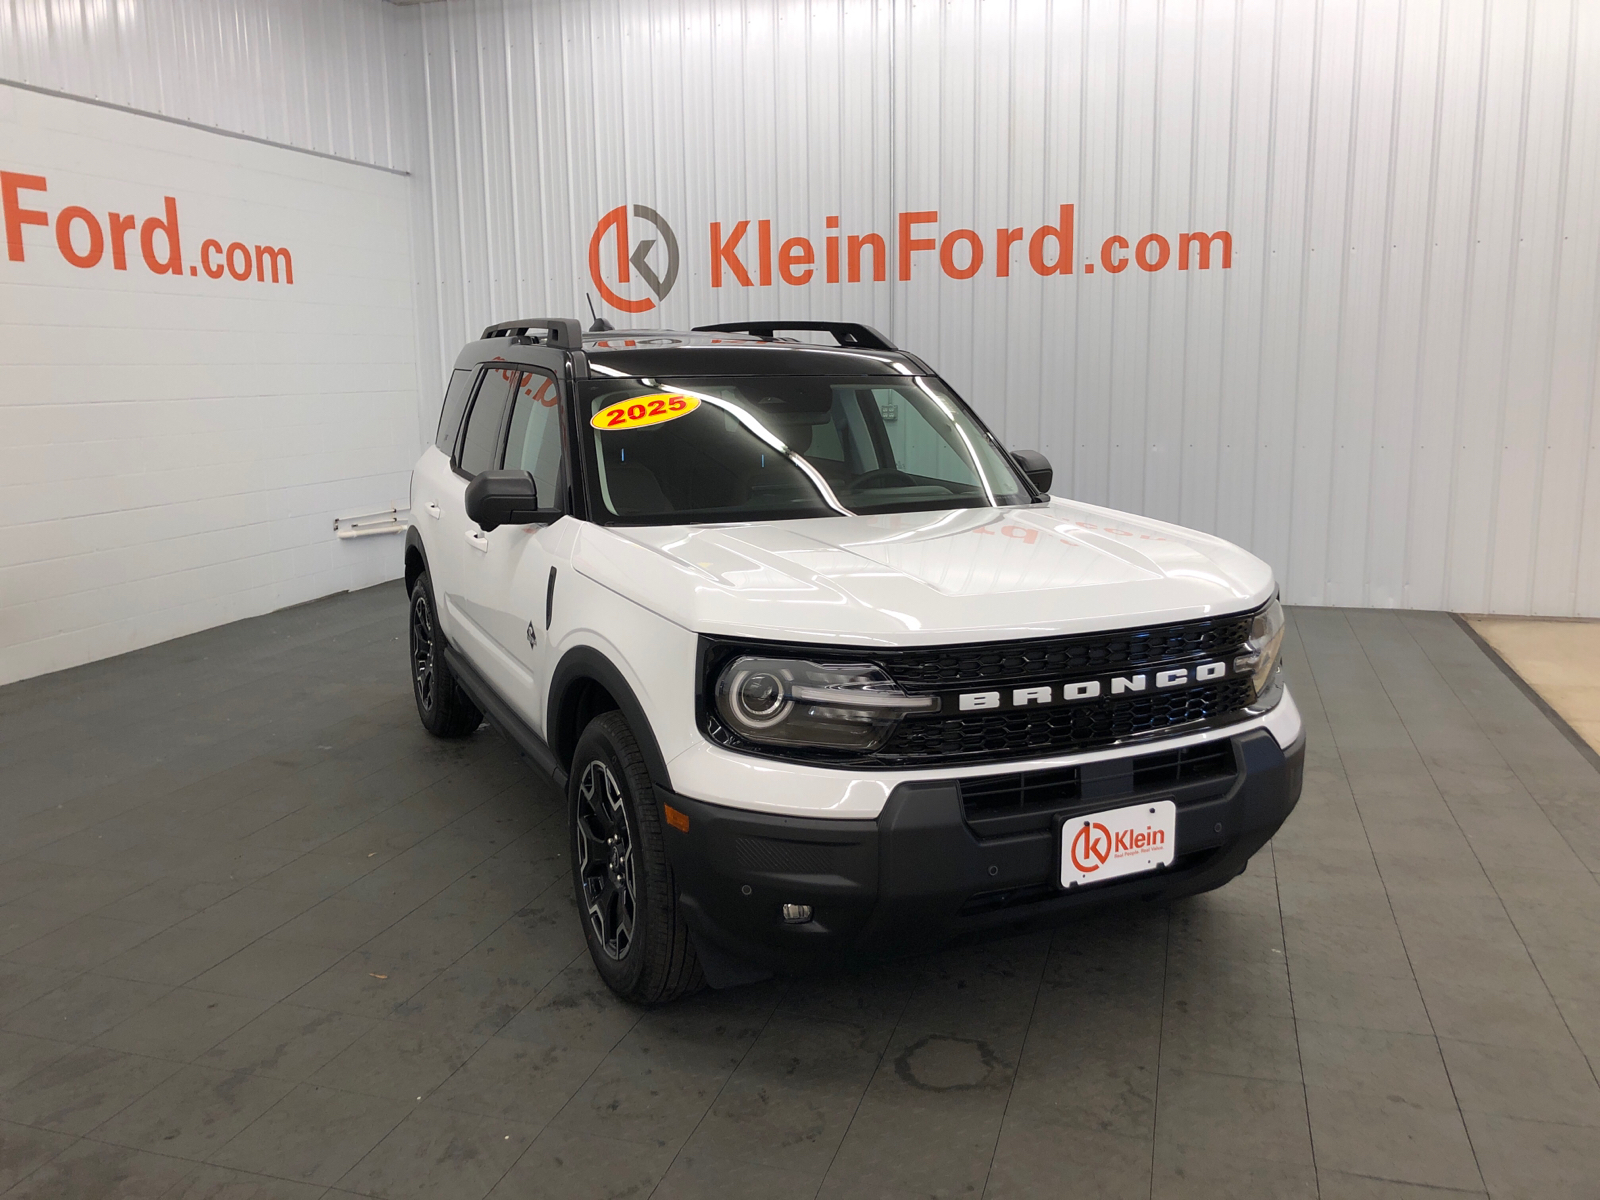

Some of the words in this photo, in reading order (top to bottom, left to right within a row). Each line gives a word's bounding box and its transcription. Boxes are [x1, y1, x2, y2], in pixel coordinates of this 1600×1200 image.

[710, 203, 1233, 288] KleinFord.com
[606, 396, 687, 427] 2025
[958, 661, 1226, 711] BRONCO
[1114, 825, 1165, 853] Klein
